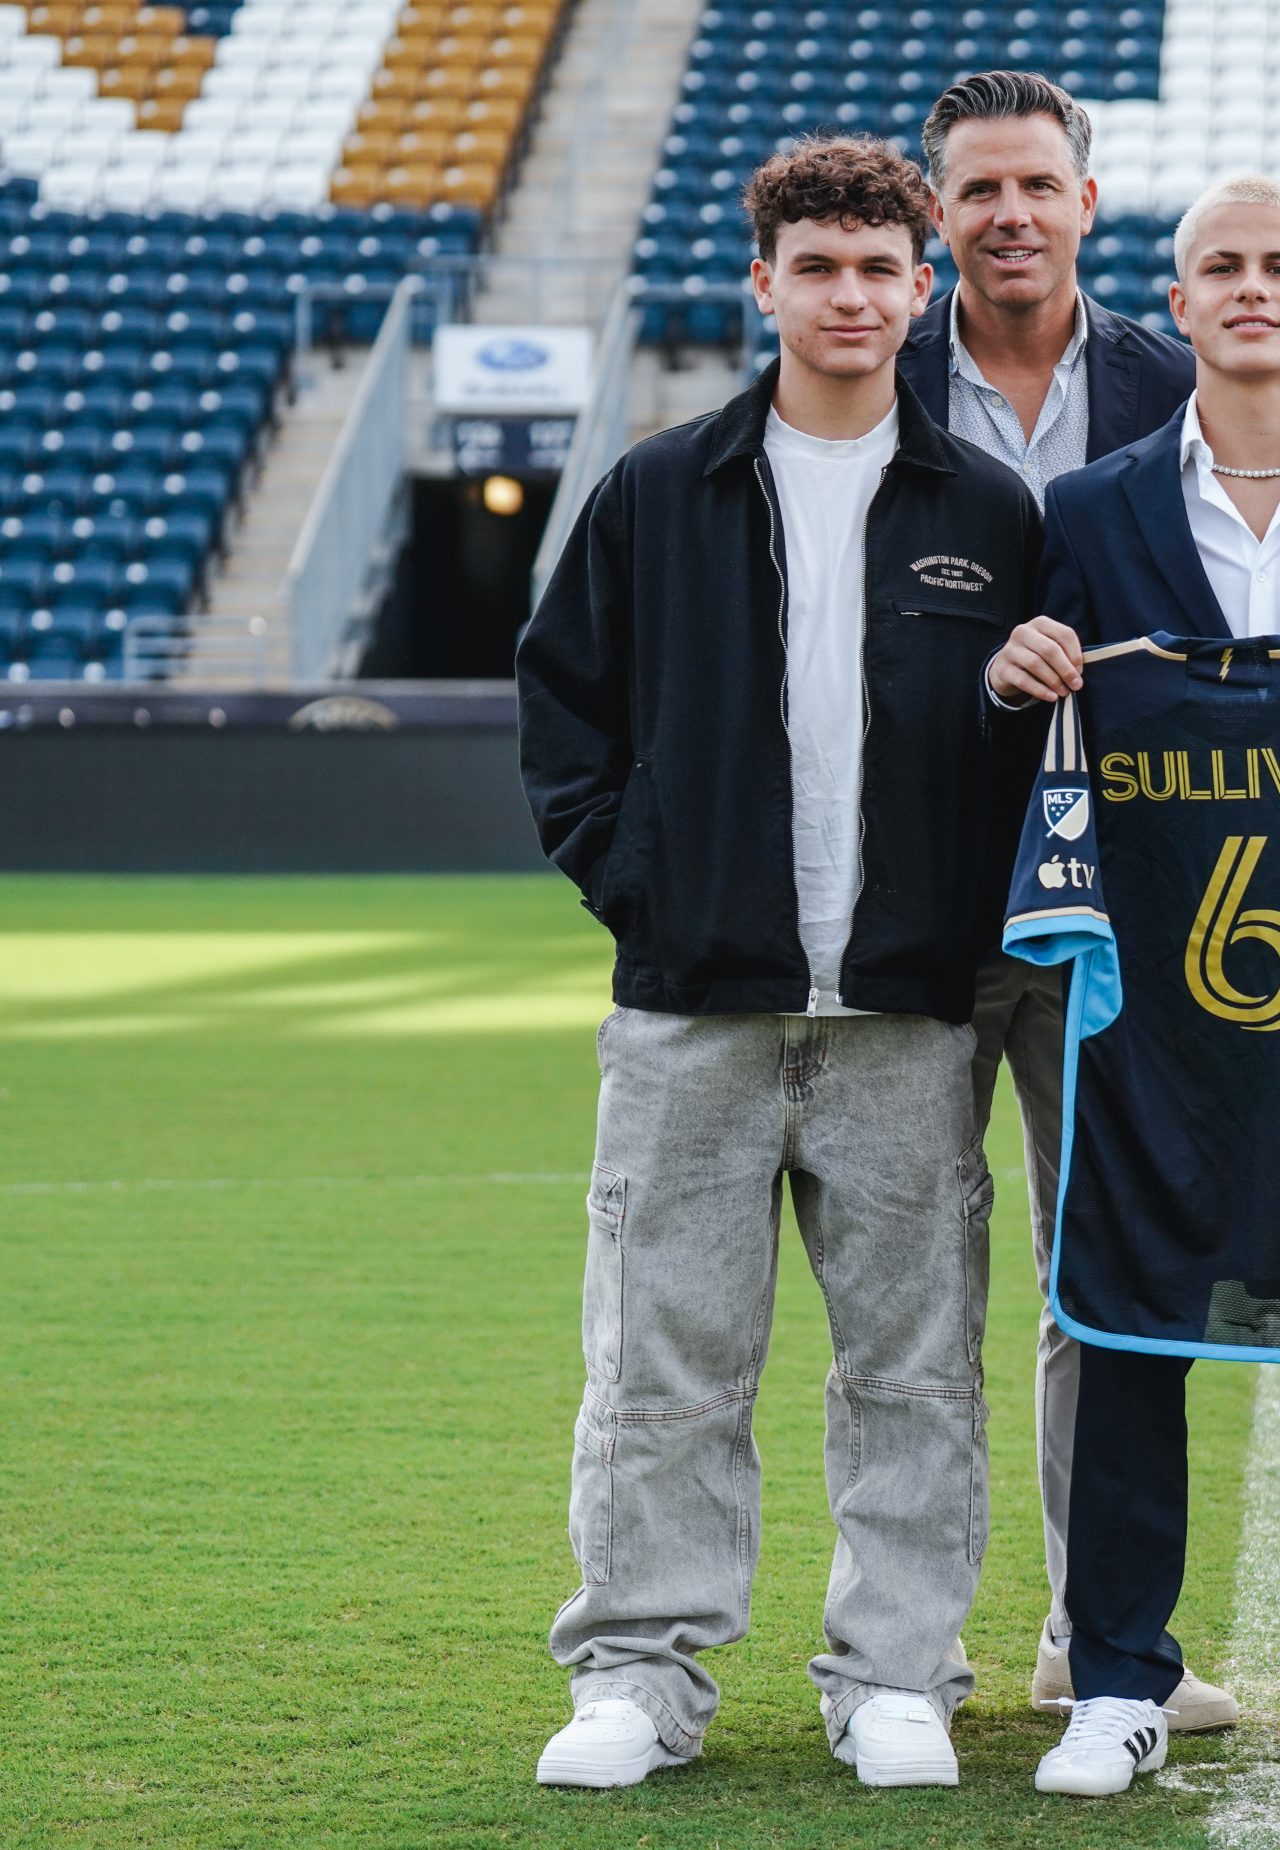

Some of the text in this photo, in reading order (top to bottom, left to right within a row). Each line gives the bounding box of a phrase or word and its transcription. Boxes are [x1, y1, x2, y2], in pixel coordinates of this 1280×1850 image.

[909, 555, 950, 572] WASHINGTON
[970, 562, 994, 583] OREGON
[920, 573, 984, 592] PACIFIC NORTHWEST
[1047, 793, 1074, 805] MLS
[1067, 857, 1095, 889] tv
